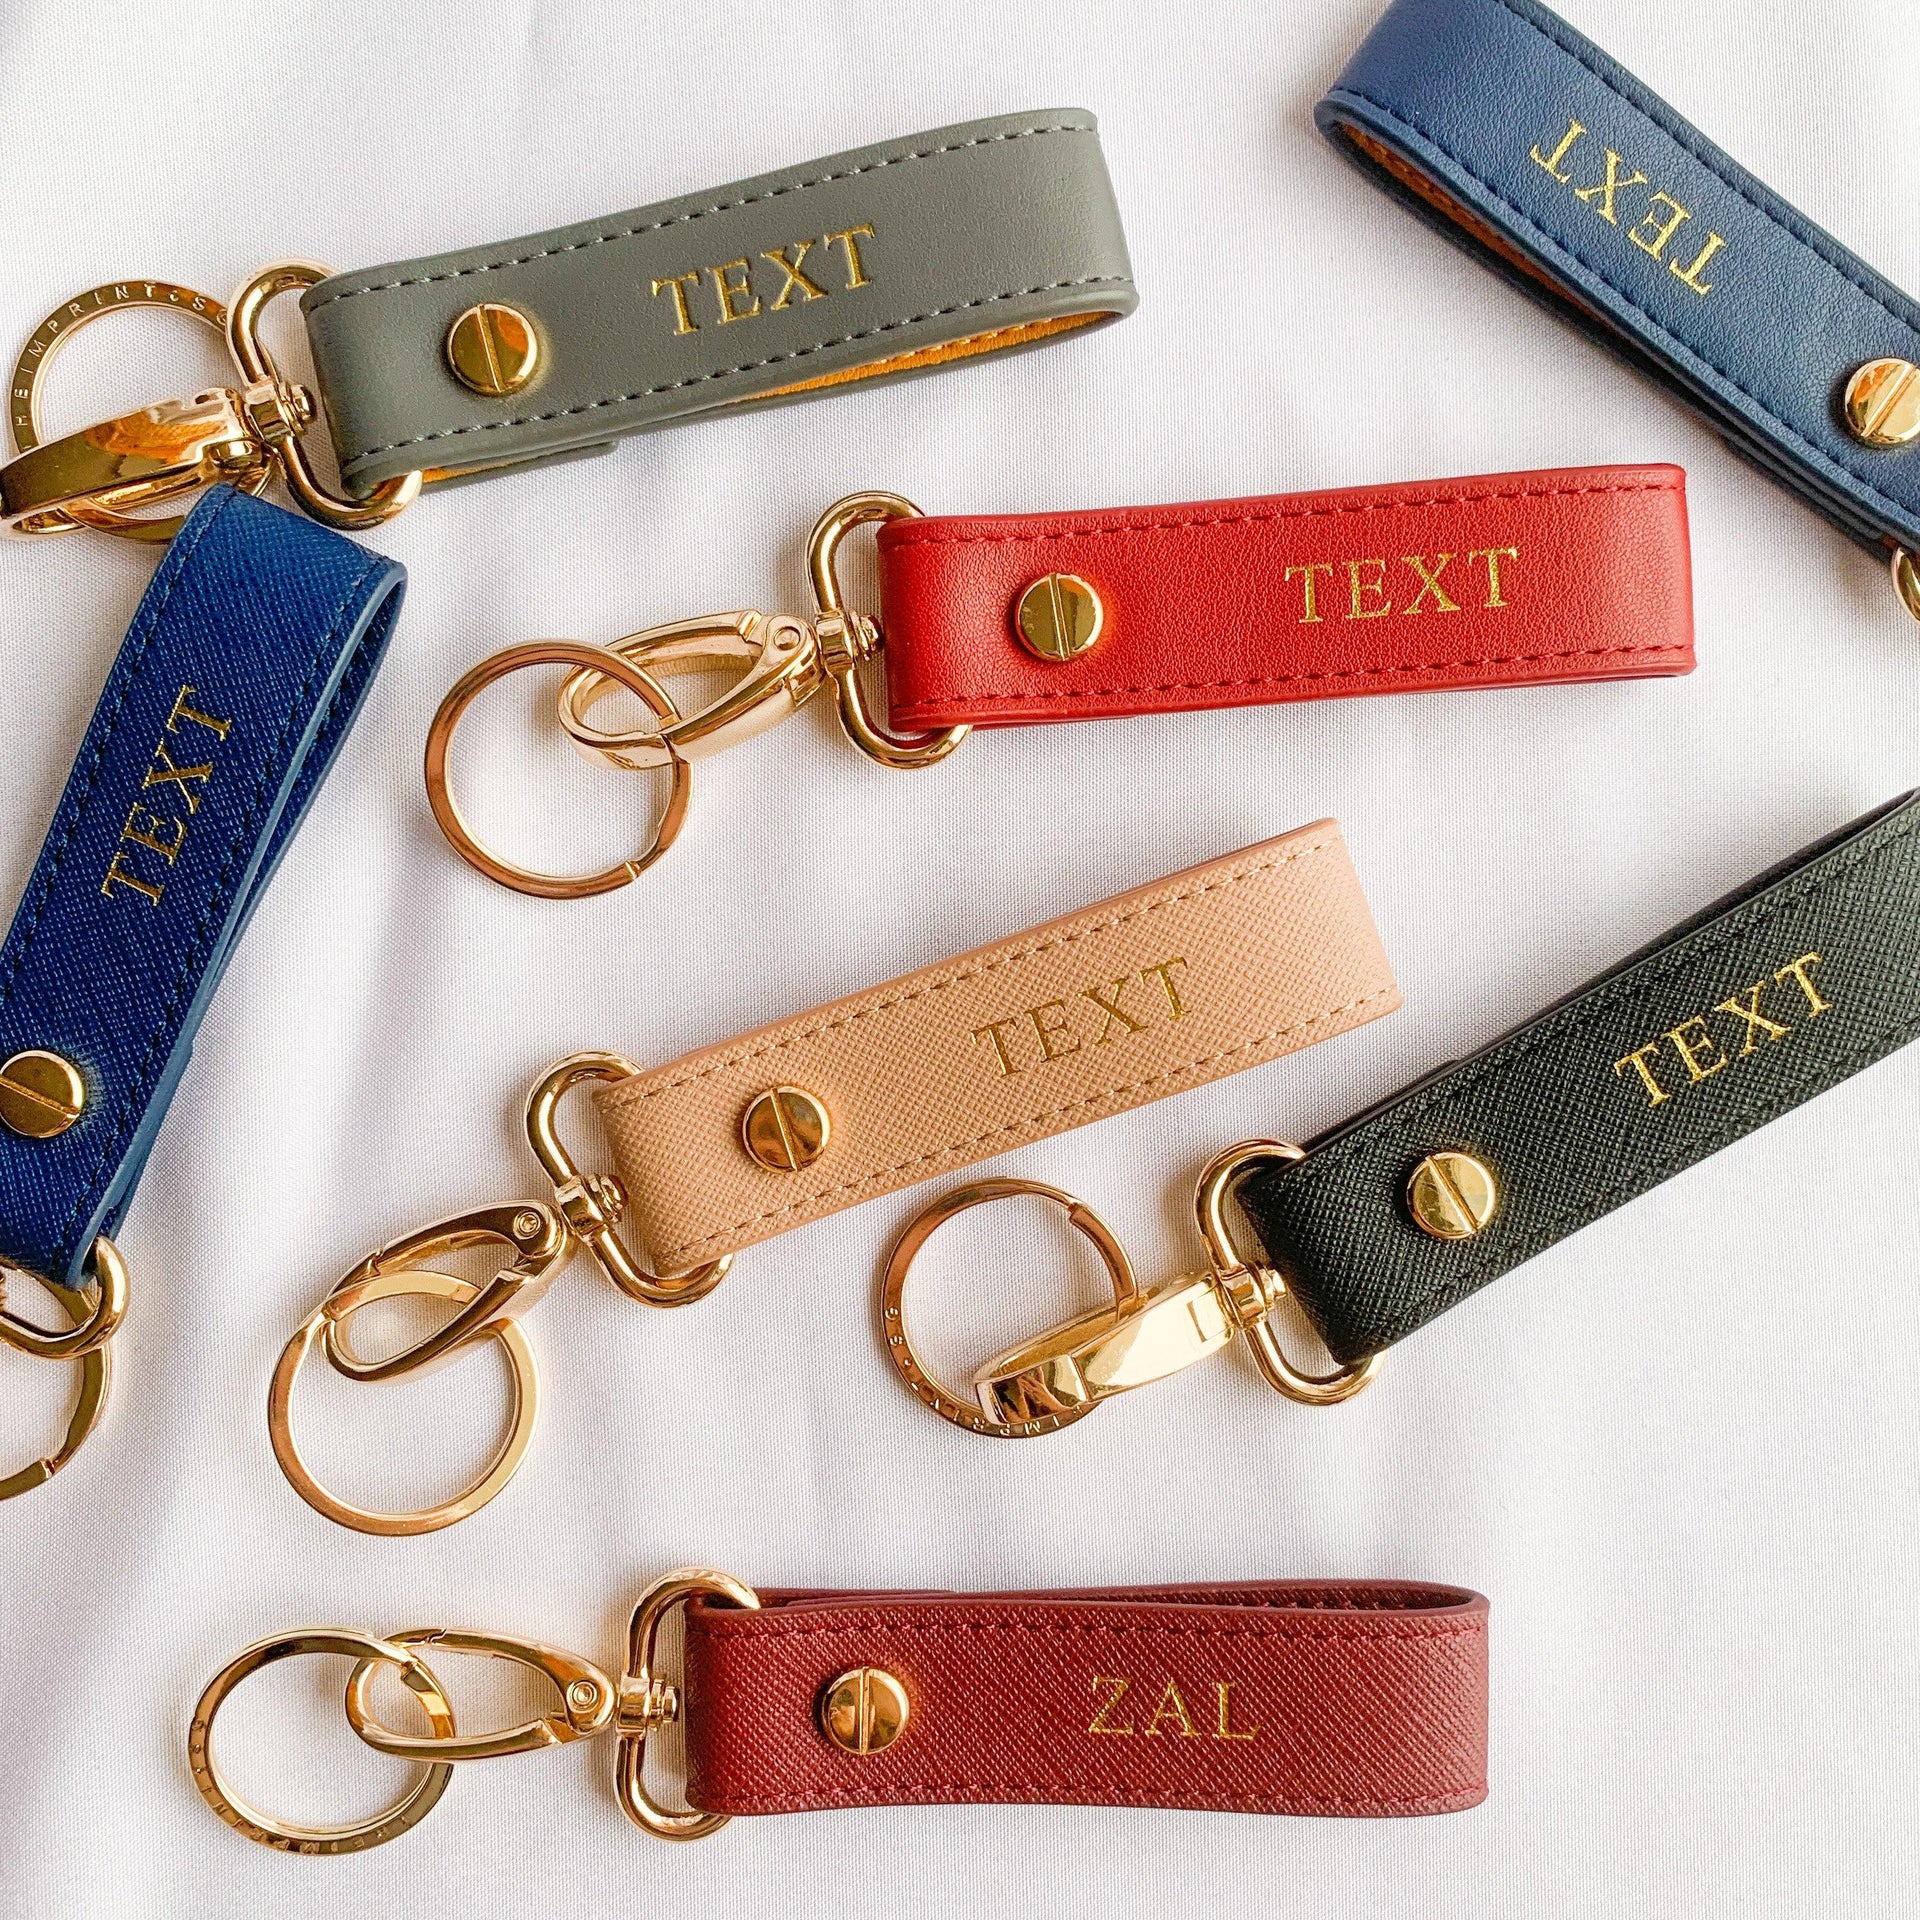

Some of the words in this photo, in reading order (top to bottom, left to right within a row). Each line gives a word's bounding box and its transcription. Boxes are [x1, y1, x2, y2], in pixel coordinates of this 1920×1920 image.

[1529, 118, 1726, 296] TEXT
[652, 223, 875, 336] TEXT
[1284, 546, 1520, 623] TEXT
[100, 684, 232, 907] TEXT
[971, 956, 1192, 1077] TEXT
[1613, 951, 1833, 1108] TEXT
[1088, 1675, 1262, 1740] ZAL
